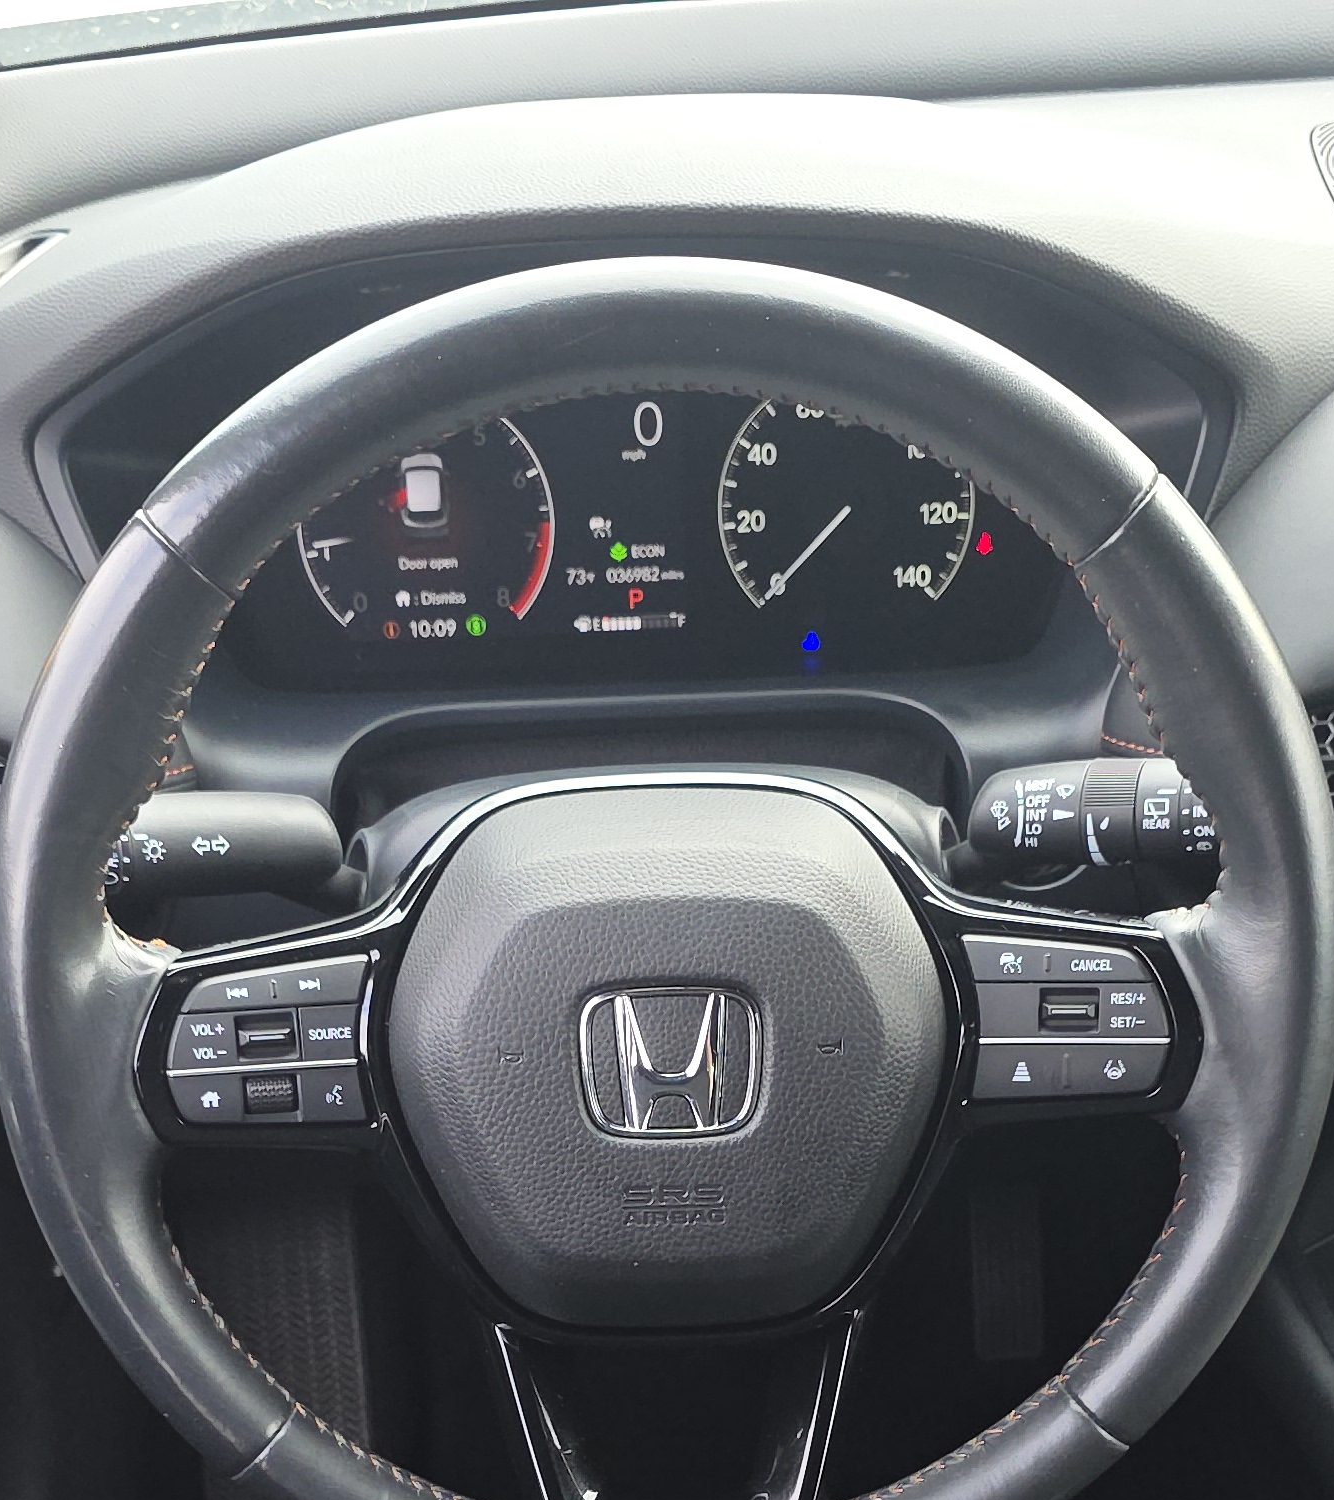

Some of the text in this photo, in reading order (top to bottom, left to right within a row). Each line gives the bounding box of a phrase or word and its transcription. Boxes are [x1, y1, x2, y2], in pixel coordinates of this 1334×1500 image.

[633, 401, 663, 447] 0
[747, 443, 778, 466] 40
[919, 501, 958, 525] 120
[736, 510, 766, 534] 20
[630, 543, 666, 559] ECON
[397, 555, 459, 572] Door open
[605, 565, 660, 584] 036982
[893, 563, 932, 588] 140
[496, 586, 510, 608] 8
[628, 587, 644, 610] P
[408, 618, 457, 638] 10:09
[1024, 778, 1055, 792] MIST
[1025, 795, 1051, 808] OFF
[1025, 809, 1048, 822] INT
[1142, 818, 1170, 830] REAR
[1025, 823, 1042, 835] LO
[1193, 825, 1216, 837] ON
[1025, 837, 1038, 848] HI
[1070, 959, 1113, 972] CANCEL
[1110, 992, 1146, 1006] RES/+
[308, 1027, 352, 1041] SOURCE
[622, 1183, 727, 1207] SRS
[624, 1208, 727, 1228] AIRBAG
